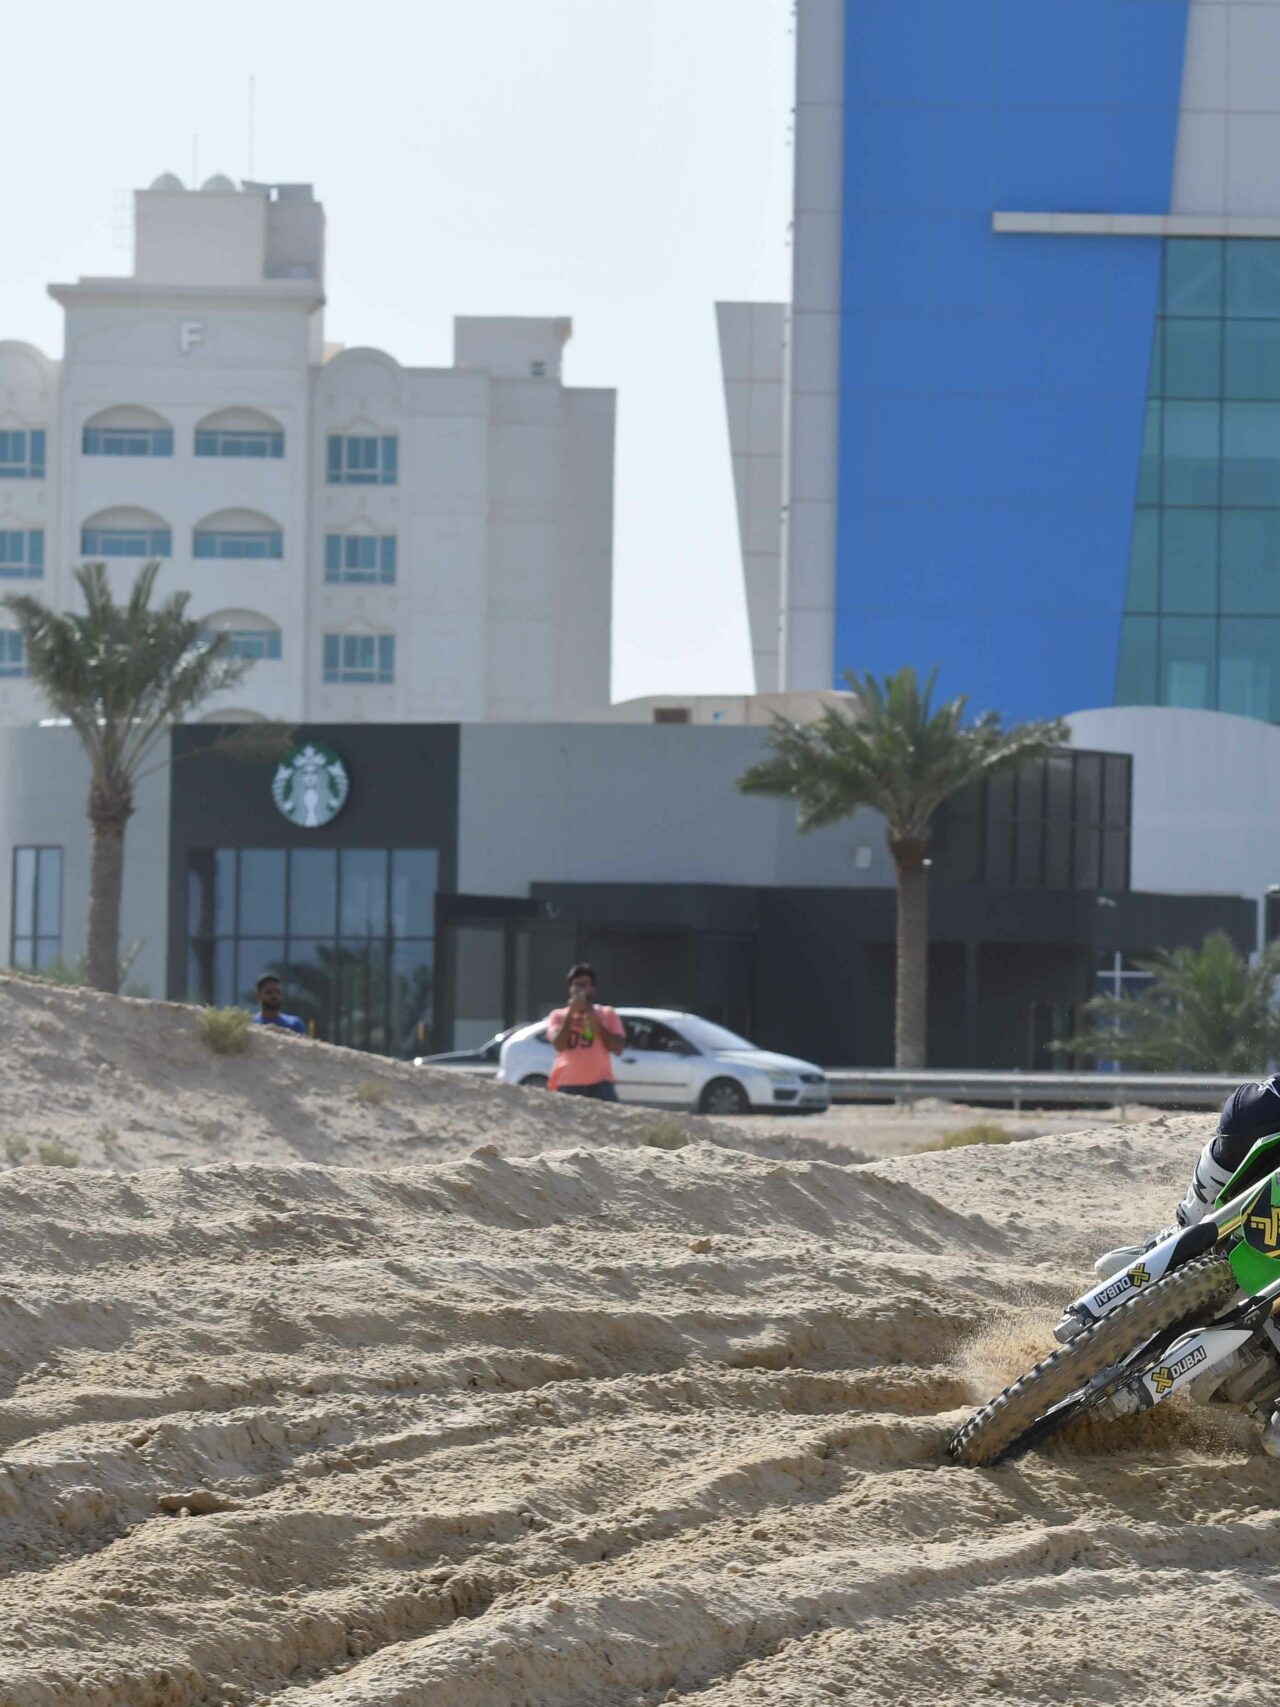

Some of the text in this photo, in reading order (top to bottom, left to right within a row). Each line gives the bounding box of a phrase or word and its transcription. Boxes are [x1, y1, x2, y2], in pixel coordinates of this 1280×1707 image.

[180, 320, 203, 353] F
[1095, 1275, 1132, 1307] DUBAI
[1170, 1346, 1206, 1379] DUBAI
